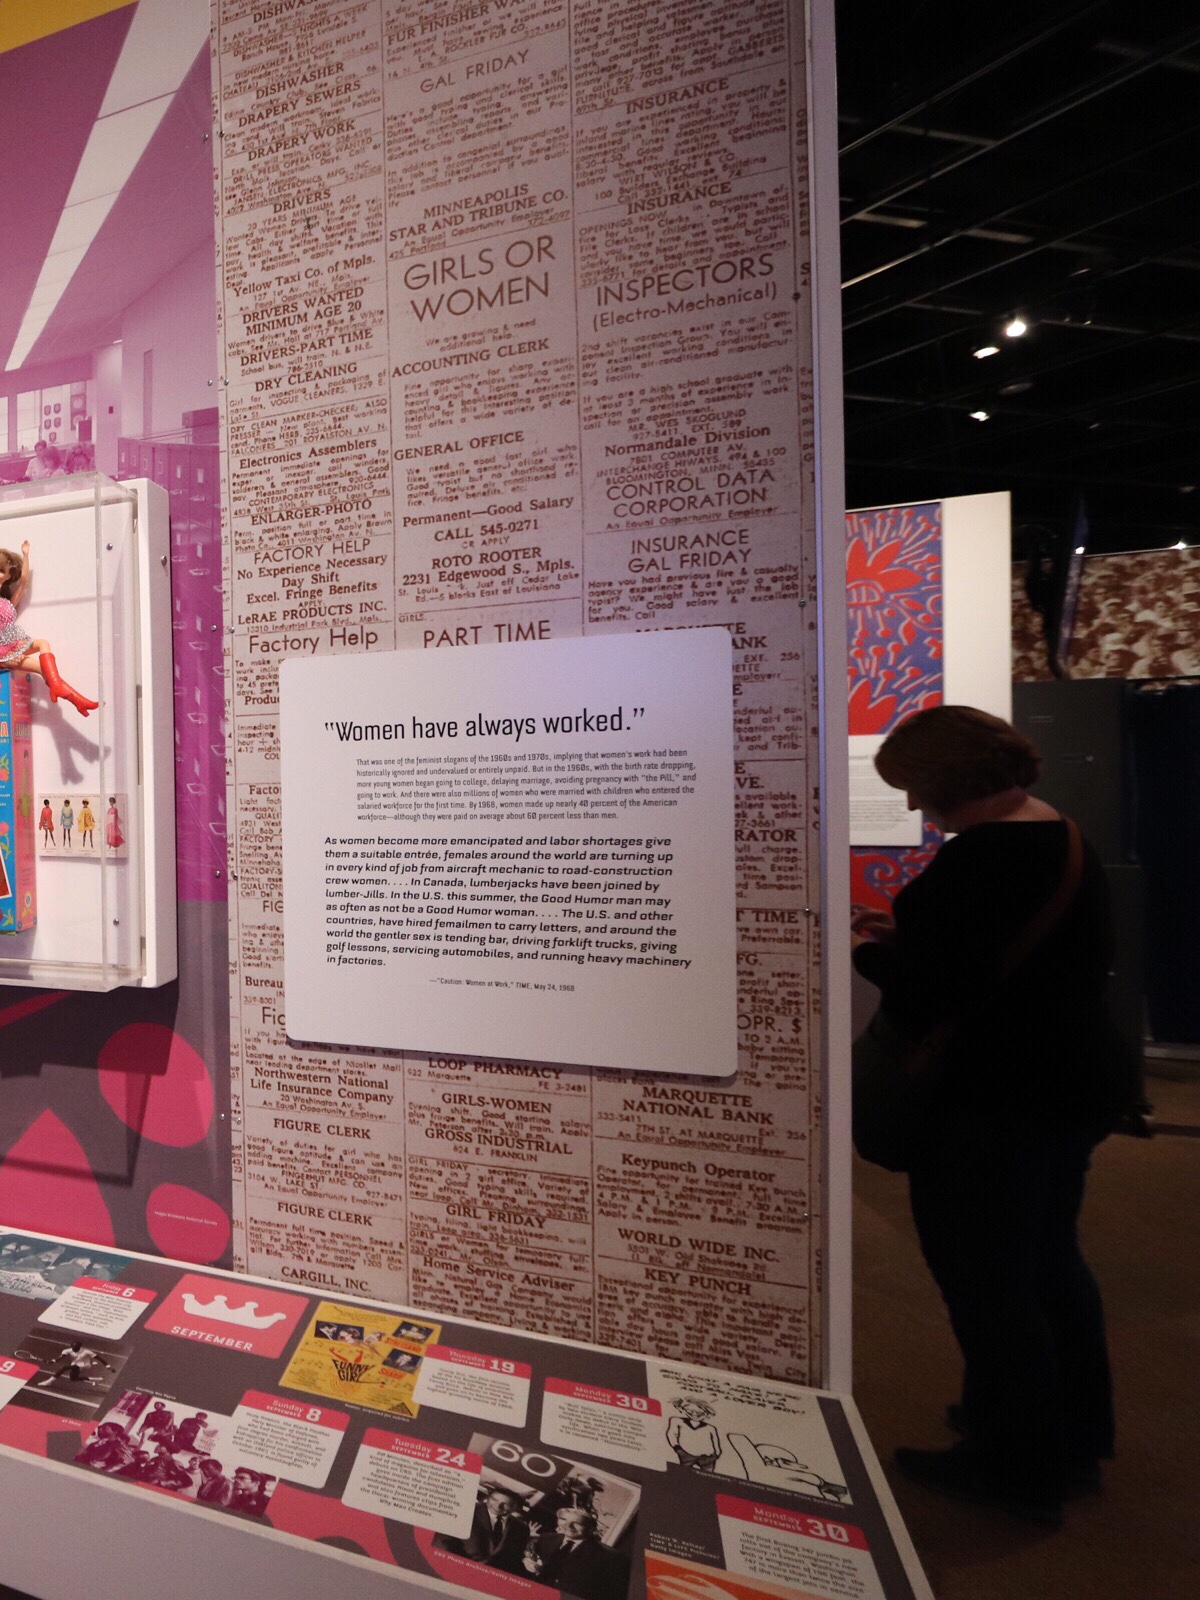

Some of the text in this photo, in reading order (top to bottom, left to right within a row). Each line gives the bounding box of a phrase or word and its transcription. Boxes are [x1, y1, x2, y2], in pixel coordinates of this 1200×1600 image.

[420, 52, 527, 92] GAL FRIDAY
[423, 184, 528, 219] MINNEAPOLIS
[389, 190, 568, 241] STAR AND TRIBUNE CO.
[232, 254, 375, 297] Yellow Taxi Co. of Mpls.
[404, 235, 555, 290] GIRLS OR
[597, 253, 774, 306] INSPECTORS
[242, 286, 363, 324] DRIVERS WANTED
[410, 271, 548, 322] WOMEN
[593, 281, 776, 332] (Electro-Mechanical)
[246, 300, 361, 336] MINIMUM AGE 20
[392, 340, 548, 377] ACCOUNTING CLERK
[255, 362, 356, 392] DRY CLEANING
[239, 439, 376, 469] Electronics Assemblers
[394, 430, 524, 462] GENERAL OFFICE
[606, 468, 774, 500] CONTROL DATA
[530, 497, 573, 510] Salary
[613, 488, 766, 517] CORPORATION
[254, 539, 370, 564] FACTORY HELP
[631, 528, 748, 554] INSURANCE
[237, 555, 387, 581] No Experience Necessary
[432, 547, 541, 569] ROTO ROOTER
[628, 548, 751, 573] GAL FRIDAY
[249, 628, 378, 654] Factory Help
[424, 620, 550, 648] PART TIME
[412, 716, 457, 738] have
[466, 713, 535, 742] always
[396, 757, 403, 766] of
[416, 756, 442, 766] feminist
[443, 755, 468, 765] slogans
[470, 754, 476, 764] of
[478, 754, 488, 762] the
[513, 753, 526, 761] and
[553, 752, 583, 761] implying
[584, 751, 598, 759] that
[633, 749, 651, 757] work
[653, 749, 666, 757] had
[324, 836, 336, 844] As
[377, 836, 418, 844] become
[450, 836, 523, 847] emancipated
[525, 836, 547, 845] and
[550, 836, 580, 845] labor
[582, 836, 642, 848] shortages
[645, 838, 670, 848] give
[336, 864, 363, 873] every
[365, 863, 387, 871] kind
[389, 863, 400, 874] of
[401, 863, 418, 874] job
[419, 863, 444, 874] from
[446, 864, 486, 875] aircraft
[488, 864, 544, 874] mechanic
[547, 866, 559, 874] to
[562, 865, 672, 875] road-construction
[338, 954, 385, 966] factories.
[516, 981, 532, 989] TIME,
[534, 983, 546, 991] May
[547, 983, 556, 991] 24,
[254, 1067, 388, 1089] Northwestern National
[250, 1078, 393, 1105] Life Insurance Company
[617, 1227, 779, 1262] WORLD WIDE INC.
[281, 1266, 370, 1291] CARGILL, INC.
[171, 1324, 253, 1350] SEPTEMBER
[0, 1360, 15, 1373] 9
[450, 1350, 487, 1364] Thursday
[490, 1359, 515, 1374] 19
[575, 1386, 611, 1398] Monday
[616, 1394, 648, 1411] 30
[273, 1400, 304, 1414] Sunday
[306, 1408, 322, 1423] 8
[395, 1438, 431, 1452] Tuesday
[436, 1448, 466, 1467] 24
[492, 1440, 556, 1477] 60
[754, 1507, 800, 1524] Monday
[806, 1518, 849, 1543] 30
